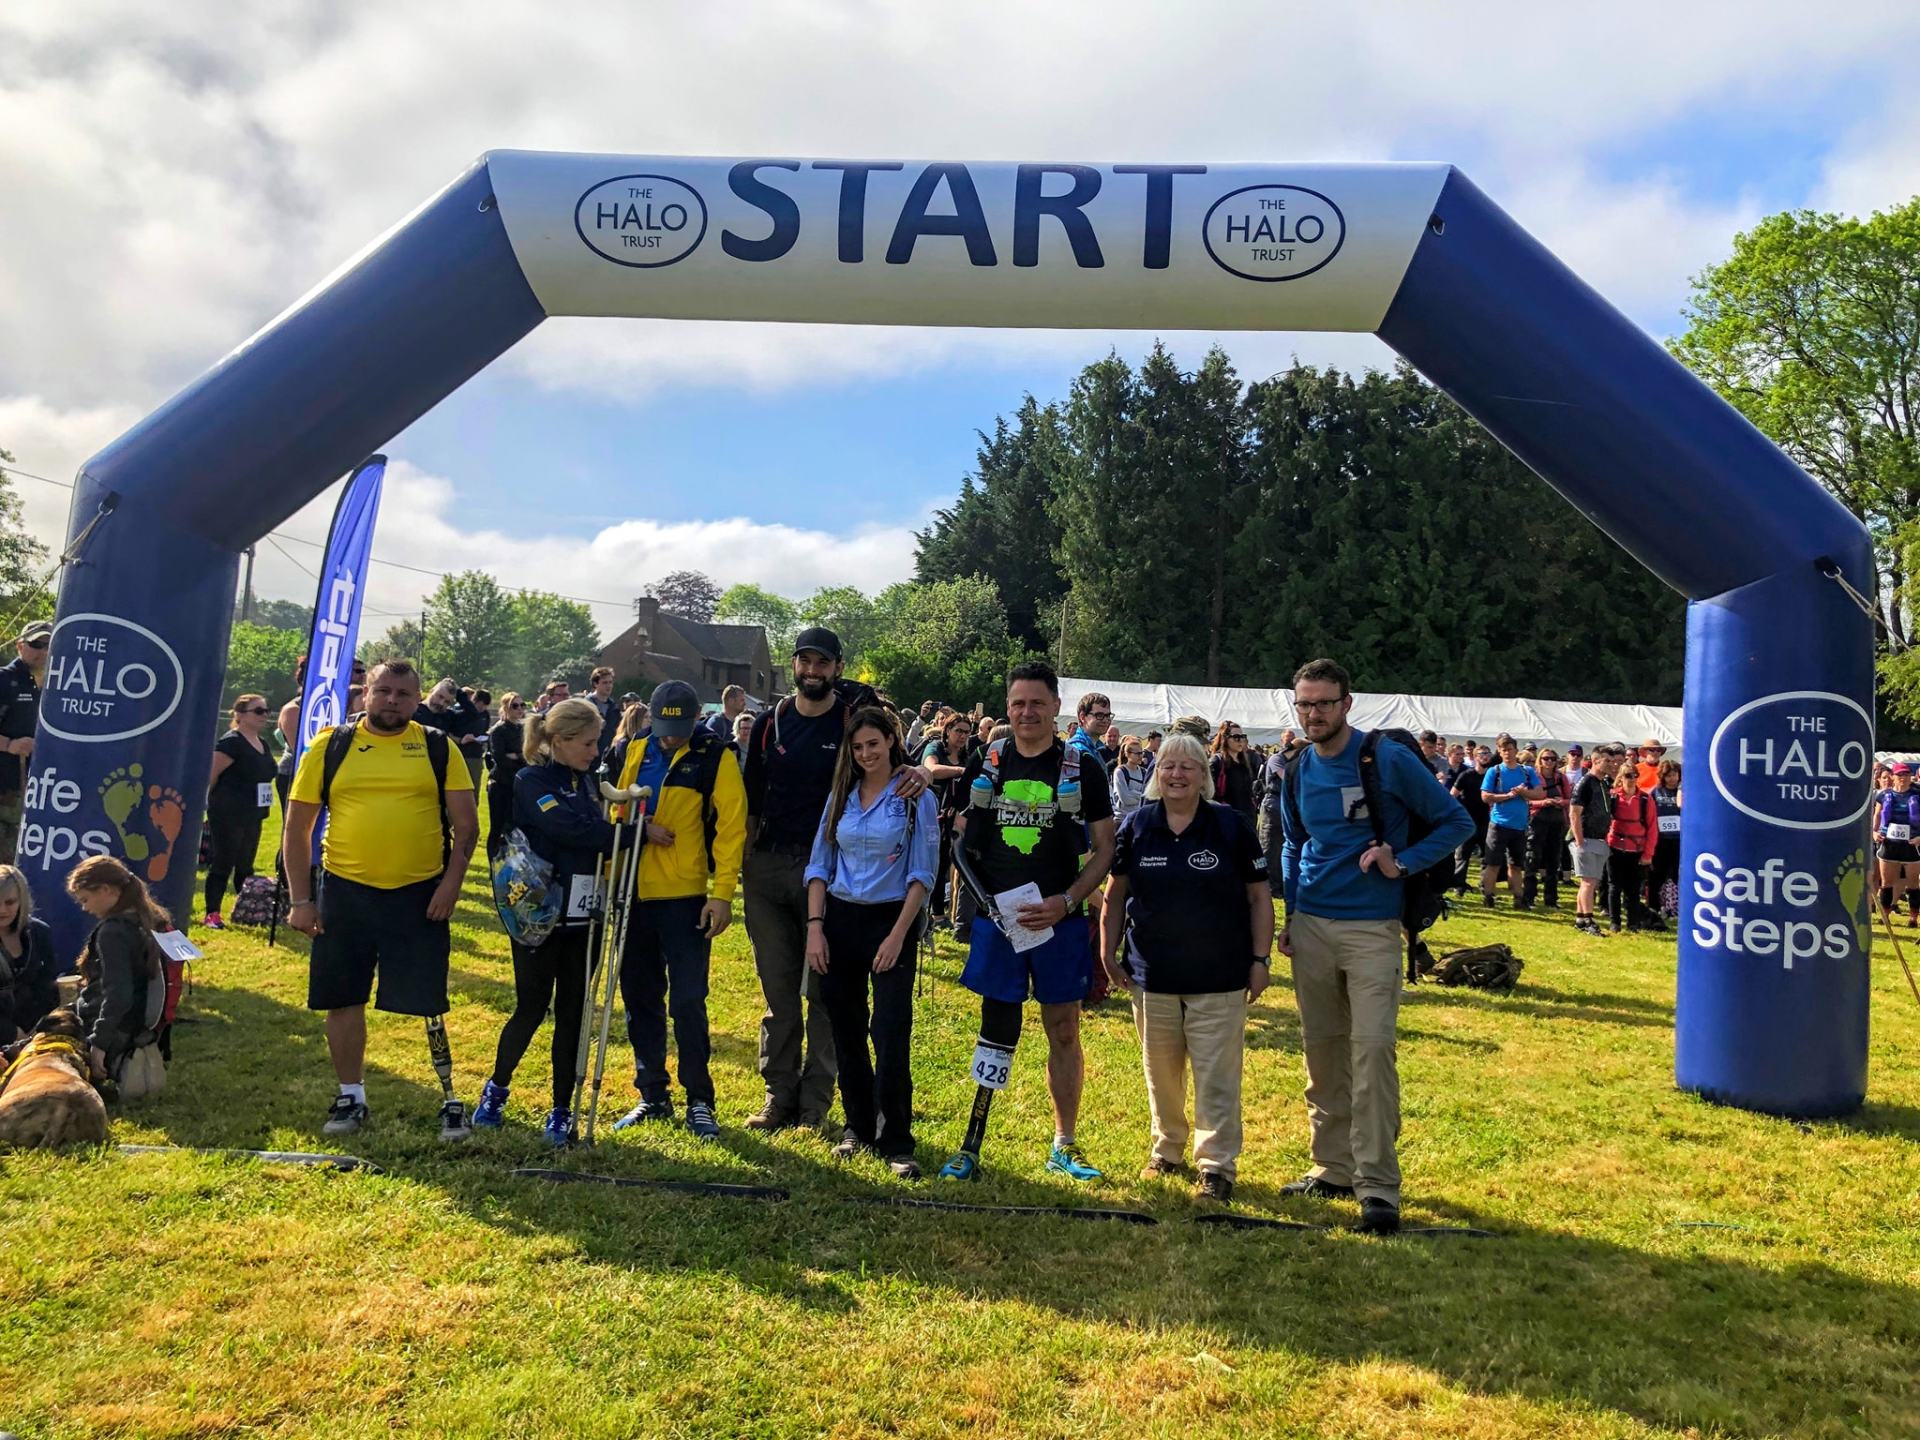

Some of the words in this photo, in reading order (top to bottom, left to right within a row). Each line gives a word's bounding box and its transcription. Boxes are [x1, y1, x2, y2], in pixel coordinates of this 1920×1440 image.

[628, 187, 653, 199] THE
[721, 159, 1207, 270] START
[1258, 199, 1286, 210] THE
[596, 202, 688, 231] HALO
[1226, 215, 1324, 244] HALO
[621, 235, 662, 248] TRUST
[1251, 248, 1296, 261] TRUST
[76, 635, 108, 653] THE
[46, 656, 157, 699] HALO
[61, 697, 115, 717] TRUST
[661, 706, 682, 717] AUS
[1786, 716, 1827, 733] THE
[1738, 737, 1866, 779] HALO
[25, 767, 82, 813] afe
[1776, 783, 1840, 801] TRUST
[1662, 822, 1677, 831] 593
[18, 813, 112, 871] teps
[1693, 852, 1819, 907] Safe
[1692, 901, 1850, 969] Steps
[976, 1060, 1008, 1084] 428
